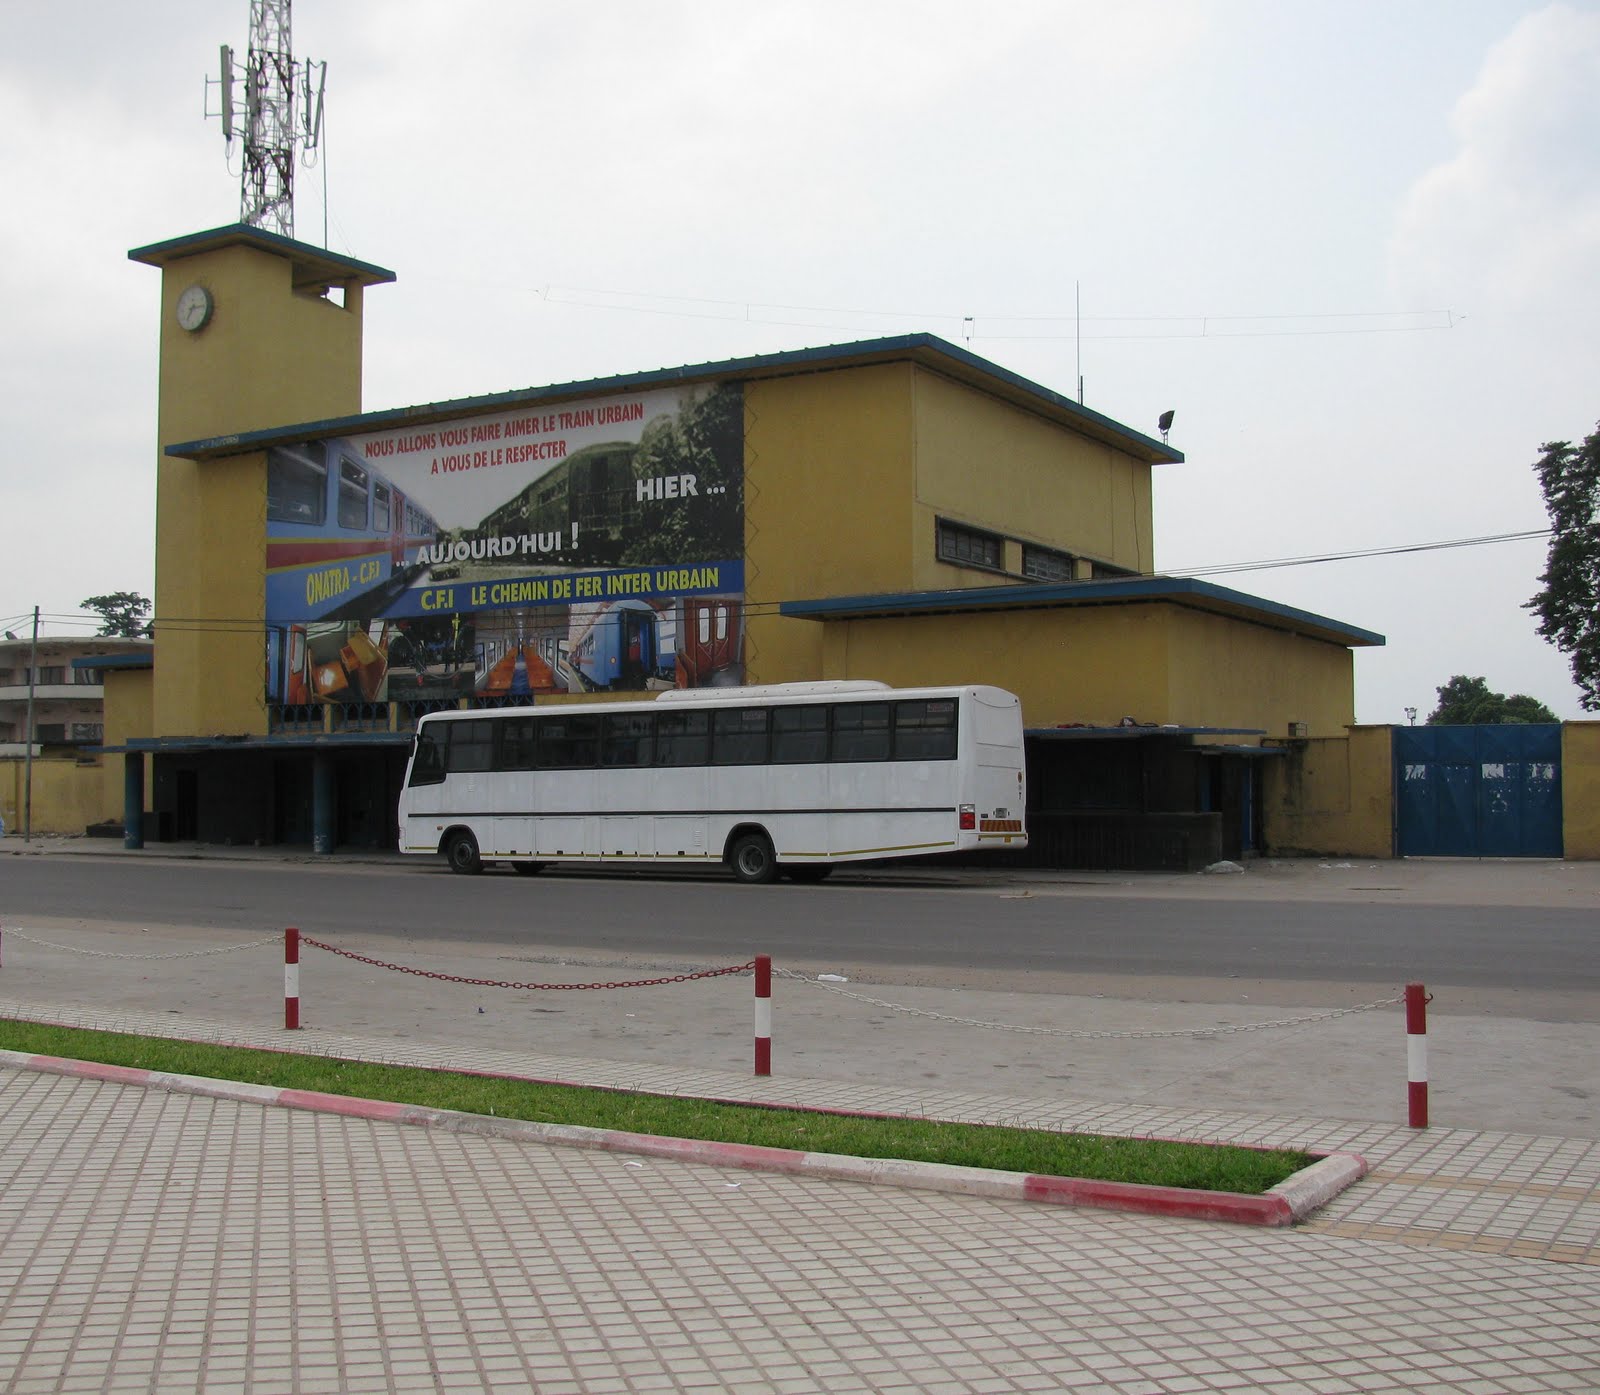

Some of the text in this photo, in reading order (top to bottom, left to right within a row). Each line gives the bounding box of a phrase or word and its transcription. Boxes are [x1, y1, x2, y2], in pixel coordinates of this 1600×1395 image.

[365, 403, 643, 458] NOUS ALLONS VOUS FAIRE AIMER LE TRAIN URBAIN
[431, 440, 567, 475] A VOUS DE LE RESPECTER
[636, 474, 699, 502] HIER
[416, 531, 562, 565] AUJOURD'HUI
[306, 567, 349, 606] ONATRA
[471, 585, 487, 605] LE
[491, 580, 548, 604] CHEMIN
[552, 578, 571, 598] DE
[576, 576, 603, 597] FER
[607, 572, 652, 594] INTER
[656, 567, 719, 591] URBAIN
